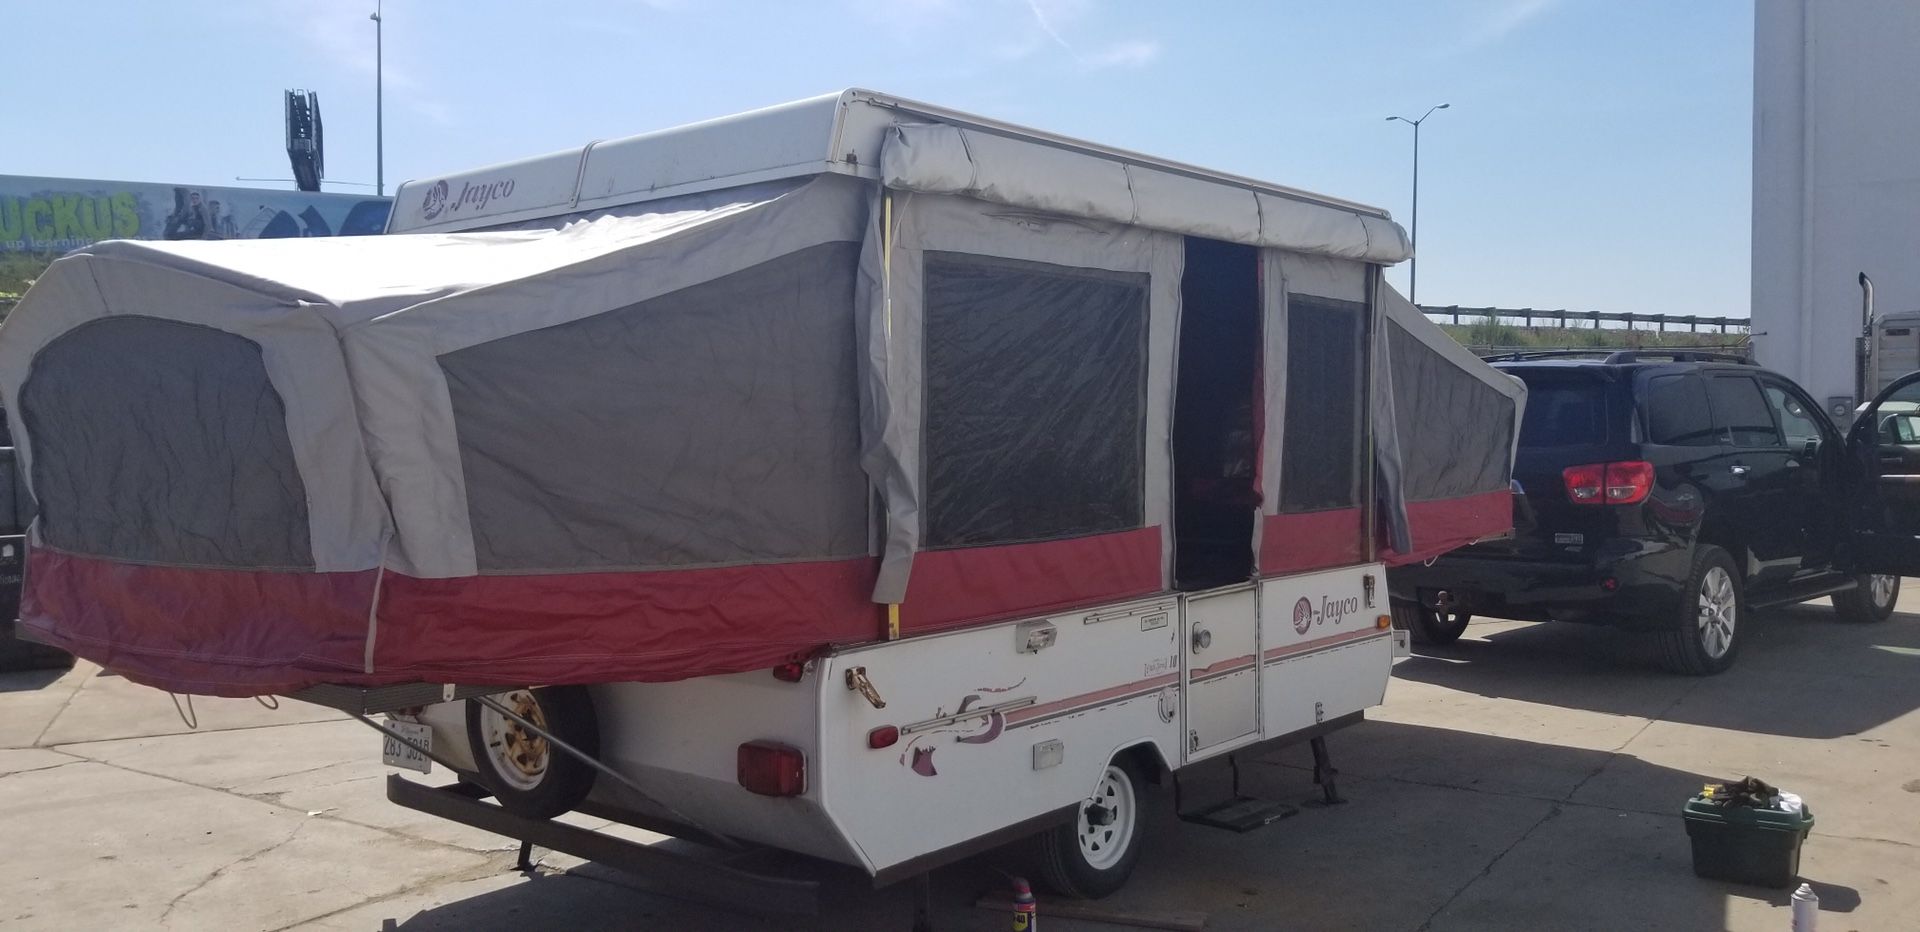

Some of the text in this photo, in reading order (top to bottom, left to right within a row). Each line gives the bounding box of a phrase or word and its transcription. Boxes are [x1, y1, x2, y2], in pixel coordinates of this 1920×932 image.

[451, 180, 515, 211] Jayco
[8, 240, 25, 250] up
[1317, 595, 1358, 625] Jayco
